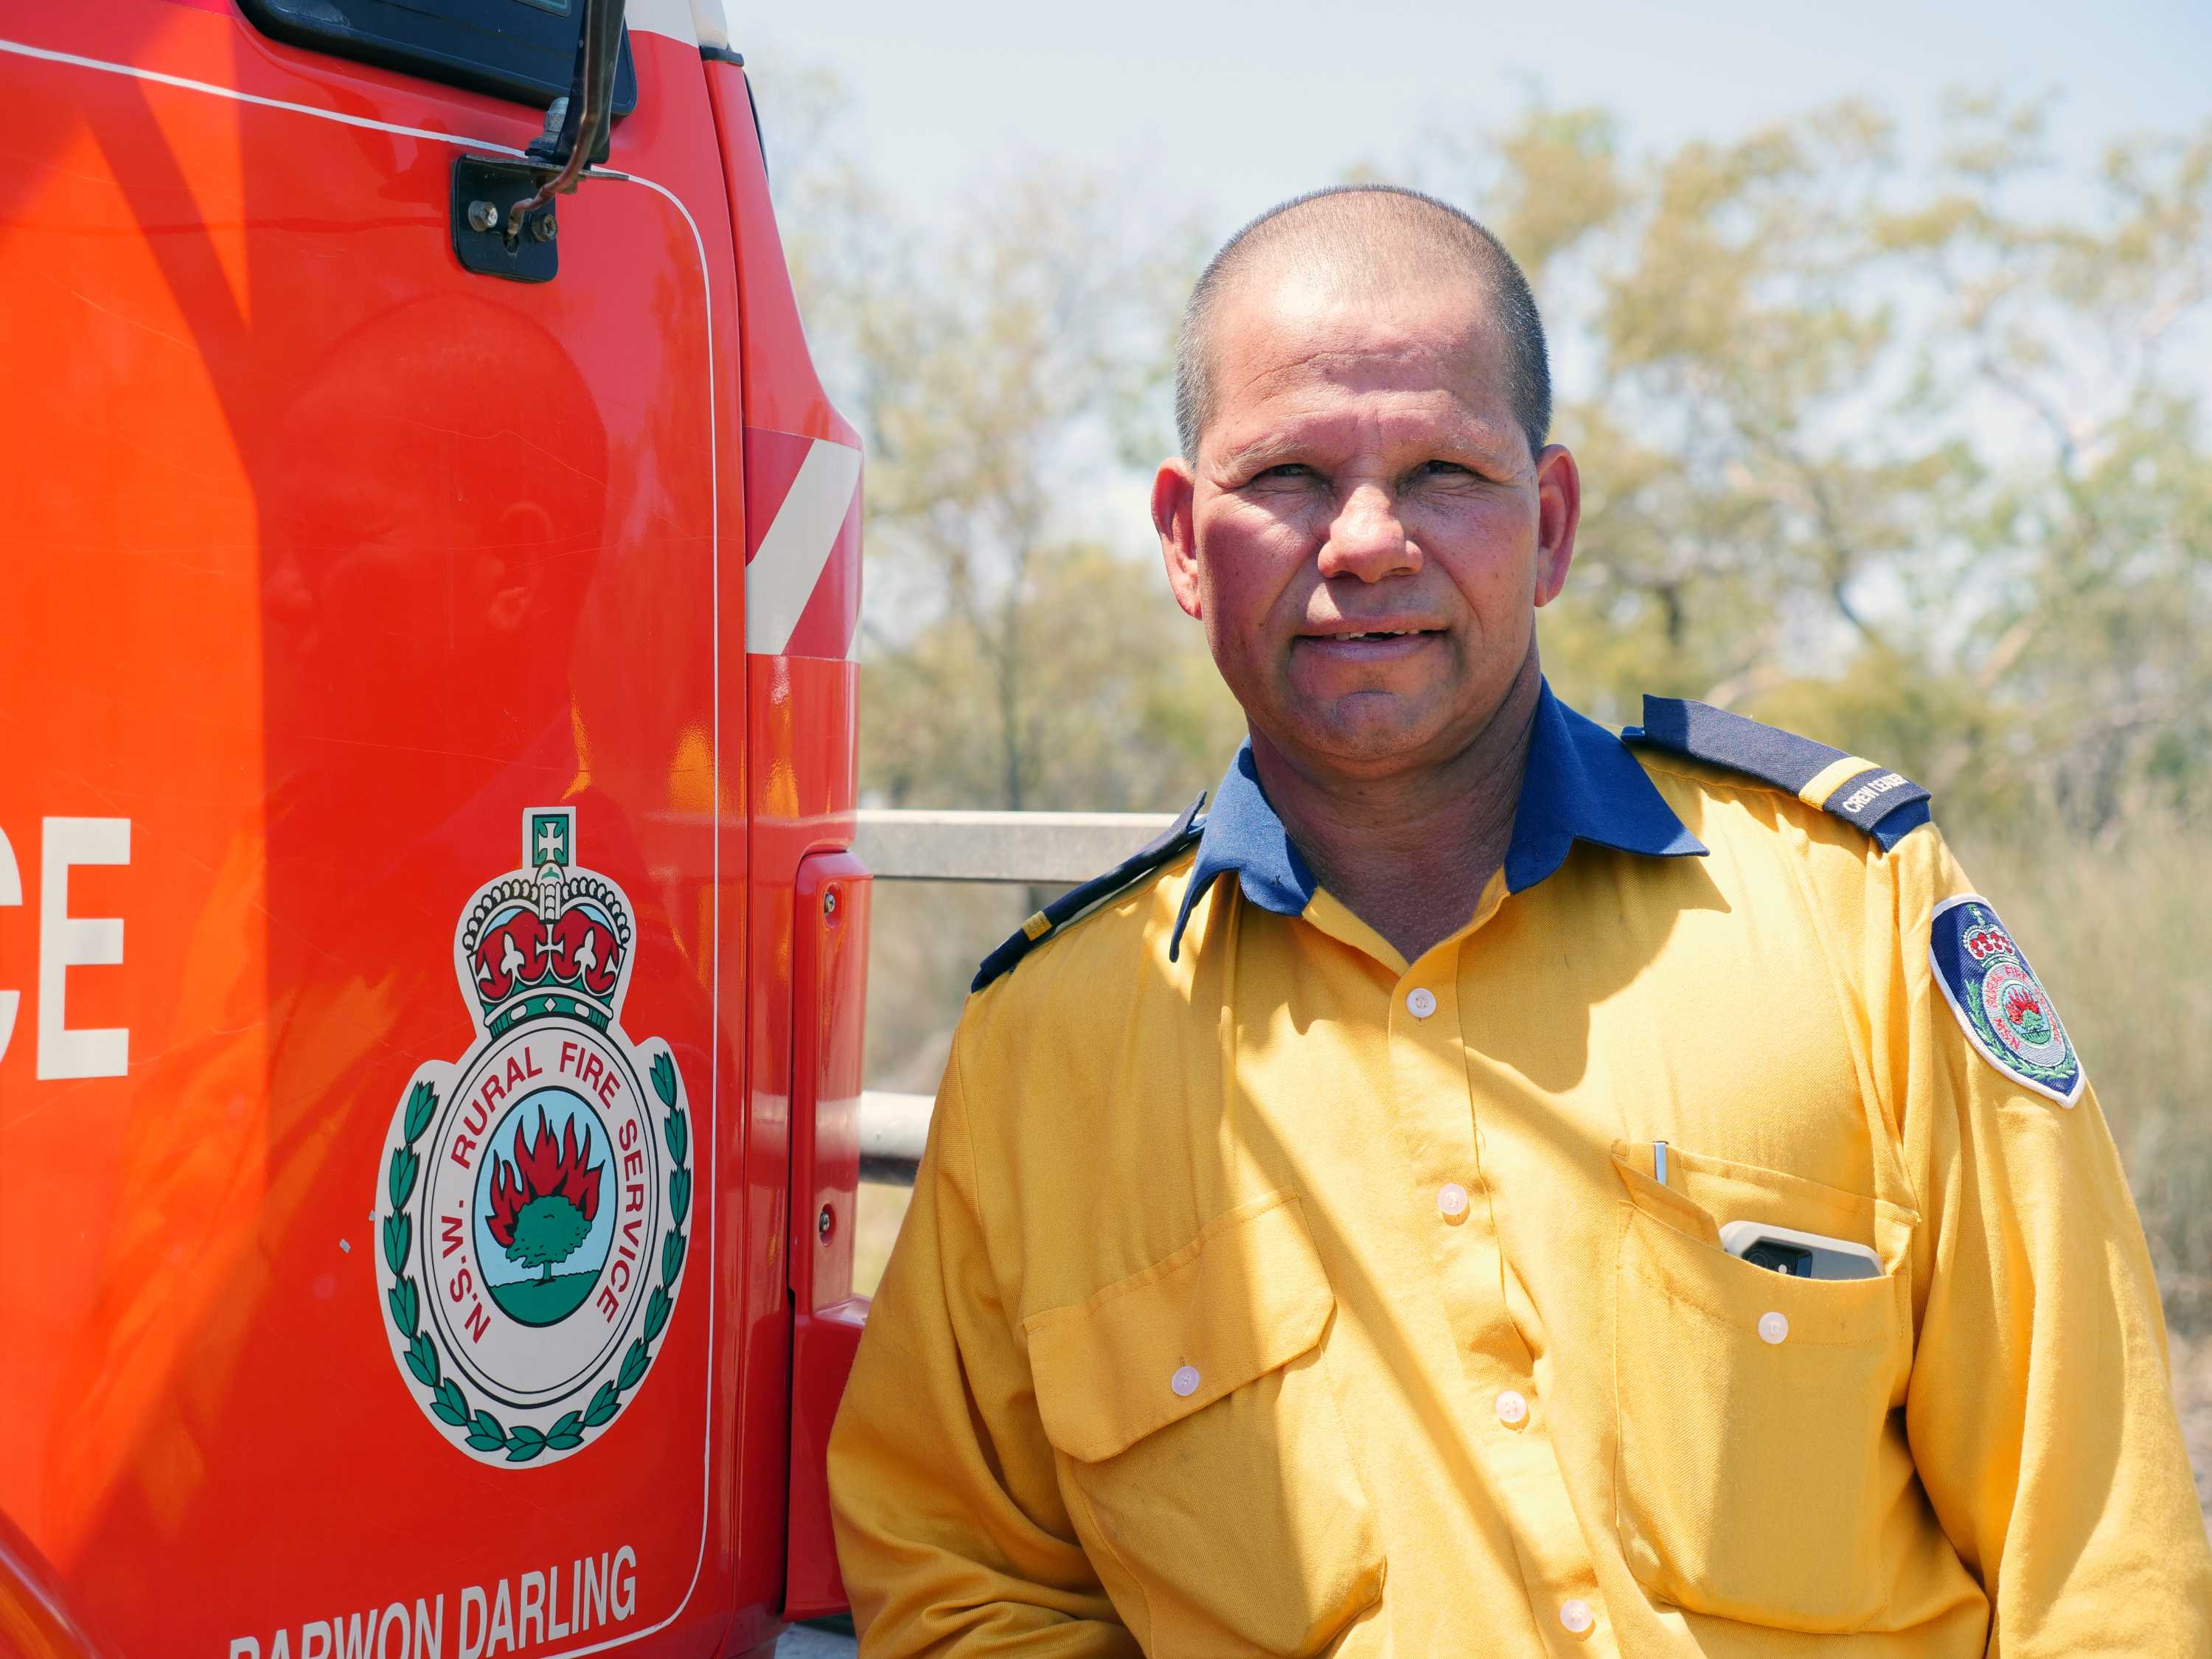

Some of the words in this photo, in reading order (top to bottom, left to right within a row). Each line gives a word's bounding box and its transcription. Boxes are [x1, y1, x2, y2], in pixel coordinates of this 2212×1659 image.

[1843, 785, 1879, 813] CREW
[0, 815, 131, 1081] E
[451, 1046, 543, 1169] RURAL
[559, 1041, 620, 1109] FIRE
[596, 1119, 644, 1323] SERVICE
[459, 1545, 636, 1659] DARLING
